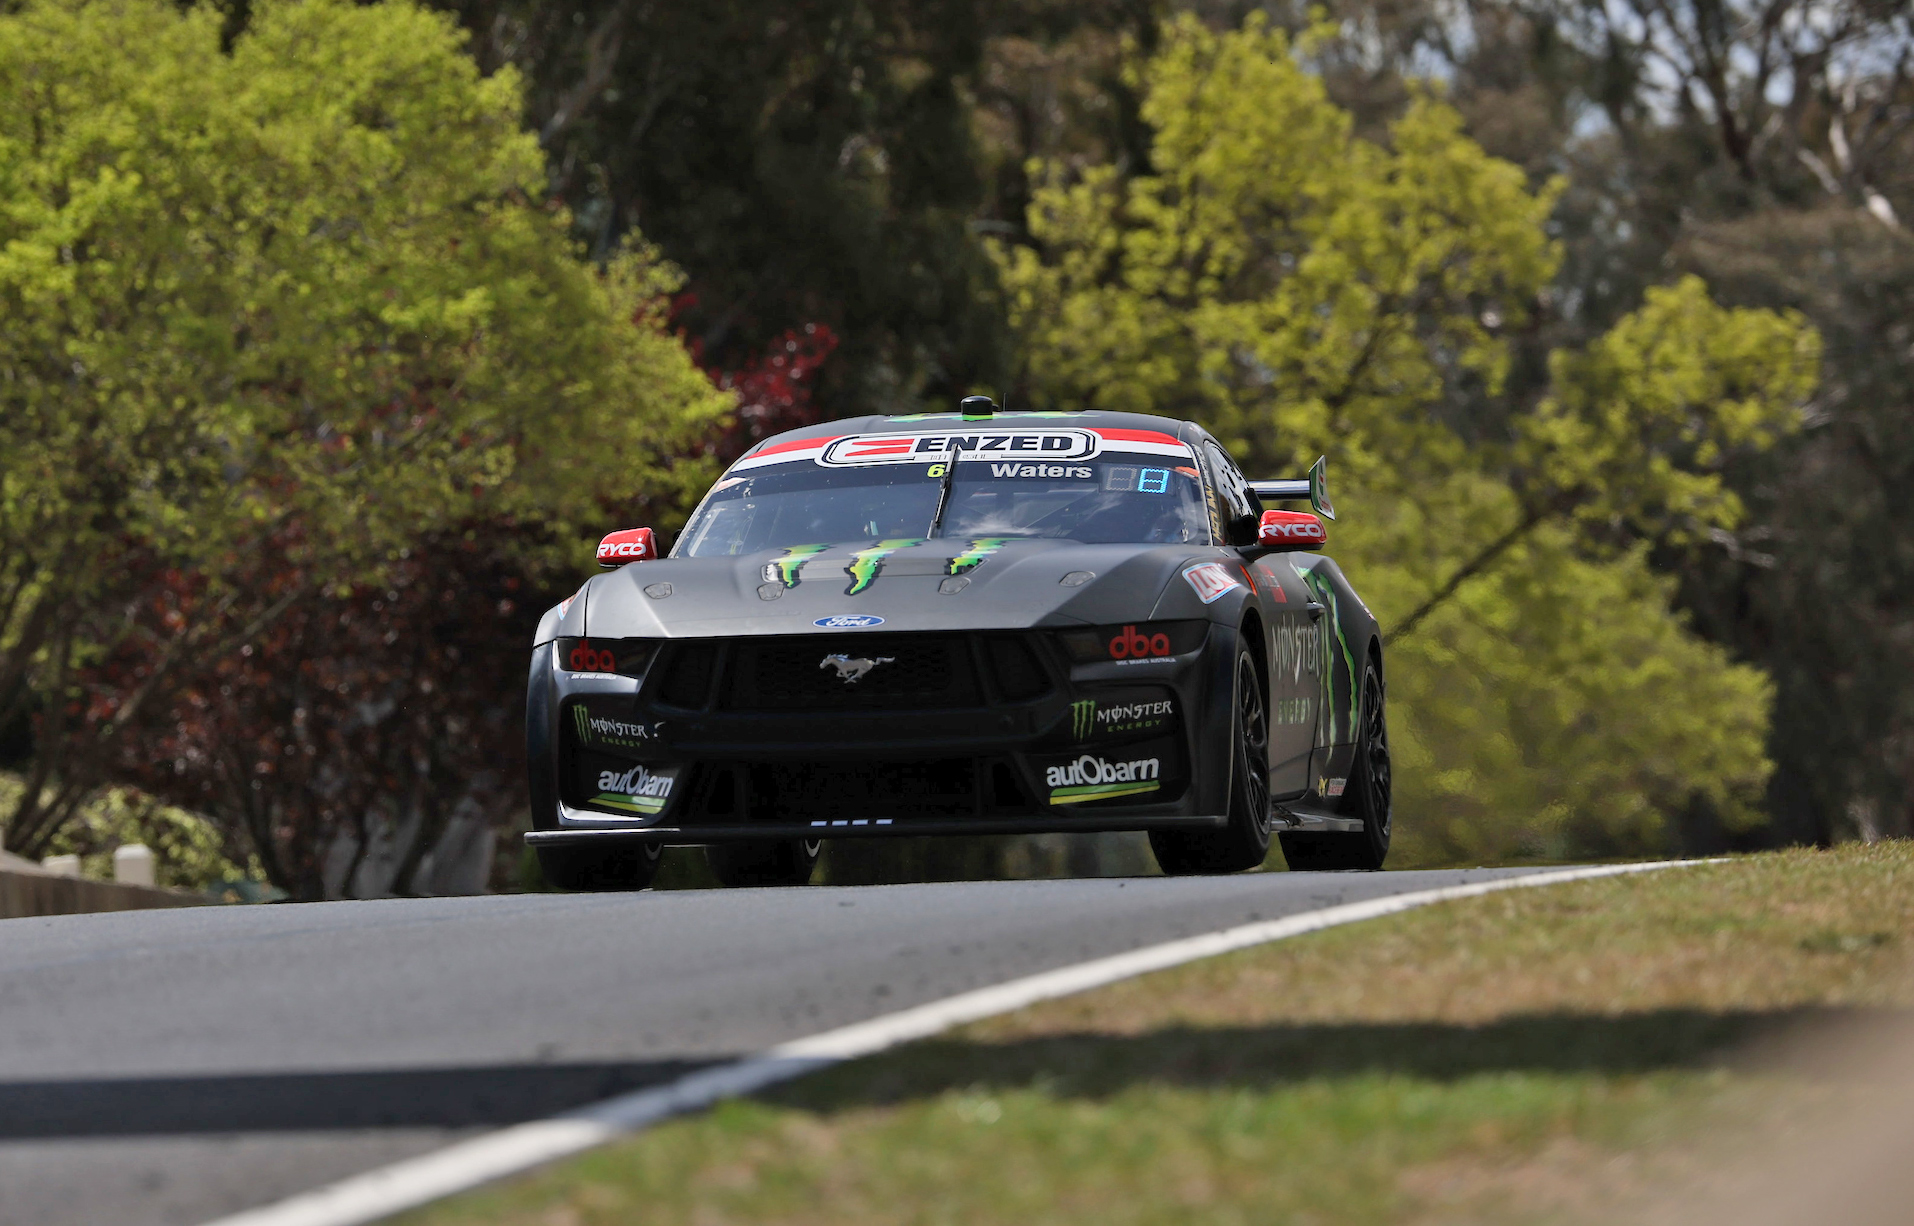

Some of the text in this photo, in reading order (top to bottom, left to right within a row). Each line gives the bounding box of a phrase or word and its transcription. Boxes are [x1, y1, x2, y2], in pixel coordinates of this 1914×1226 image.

[915, 435, 1073, 453] ENZED
[990, 463, 1093, 478] Waters
[1259, 523, 1322, 538] RYCO
[599, 542, 647, 557] RYCO
[826, 616, 872, 628] Ford
[1109, 625, 1171, 659] dba
[570, 640, 615, 672] dba
[1096, 700, 1173, 724] MONSTER
[589, 717, 648, 739] MONSTER
[1107, 719, 1162, 733] ENERGY
